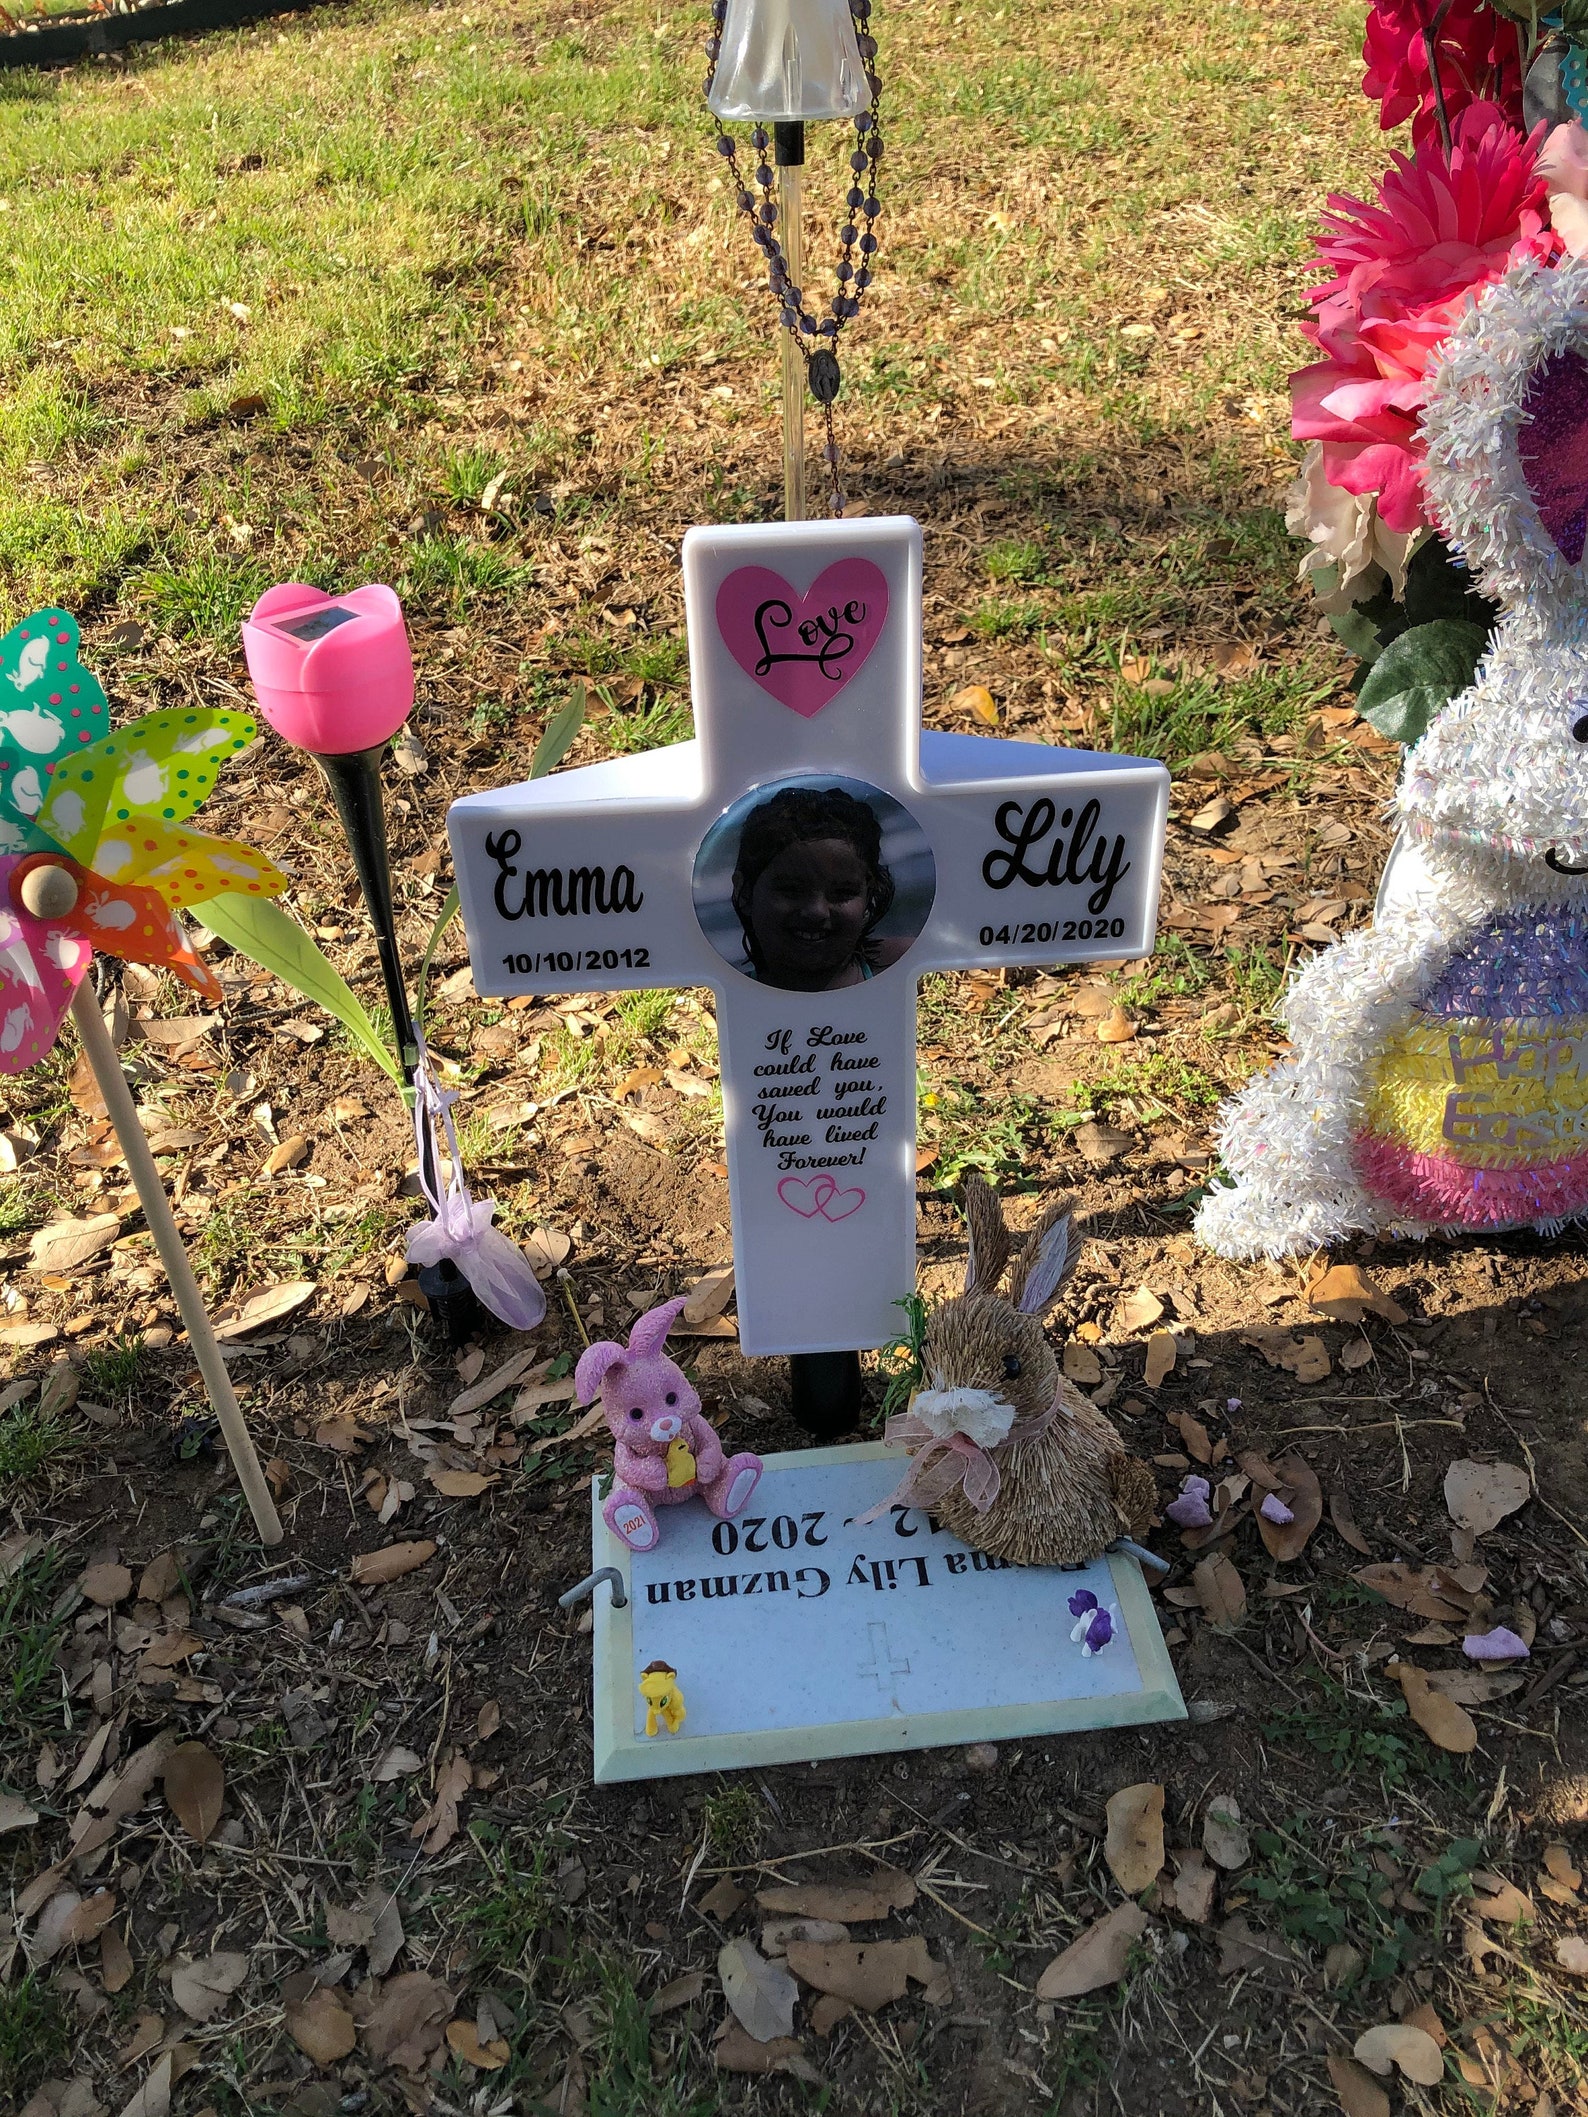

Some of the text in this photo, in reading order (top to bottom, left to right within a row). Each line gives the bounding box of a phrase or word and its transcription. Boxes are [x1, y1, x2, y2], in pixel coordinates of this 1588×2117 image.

[753, 599, 867, 681] Love
[981, 797, 1132, 917] Lily
[486, 828, 644, 922] Emma
[978, 916, 1127, 948] 04/20/2020
[502, 946, 651, 976] 10/10/2012
[764, 1025, 868, 1055] If Love
[753, 1051, 881, 1077] could have
[757, 1076, 884, 1101] saved you,
[752, 1096, 887, 1131] You would
[762, 1121, 879, 1148] have lived
[777, 1147, 867, 1171] Forever!
[623, 1514, 647, 1535] 2021
[711, 1511, 829, 1556] 2020
[644, 1566, 832, 1605] Guzman
[847, 1553, 934, 1592] Lily
